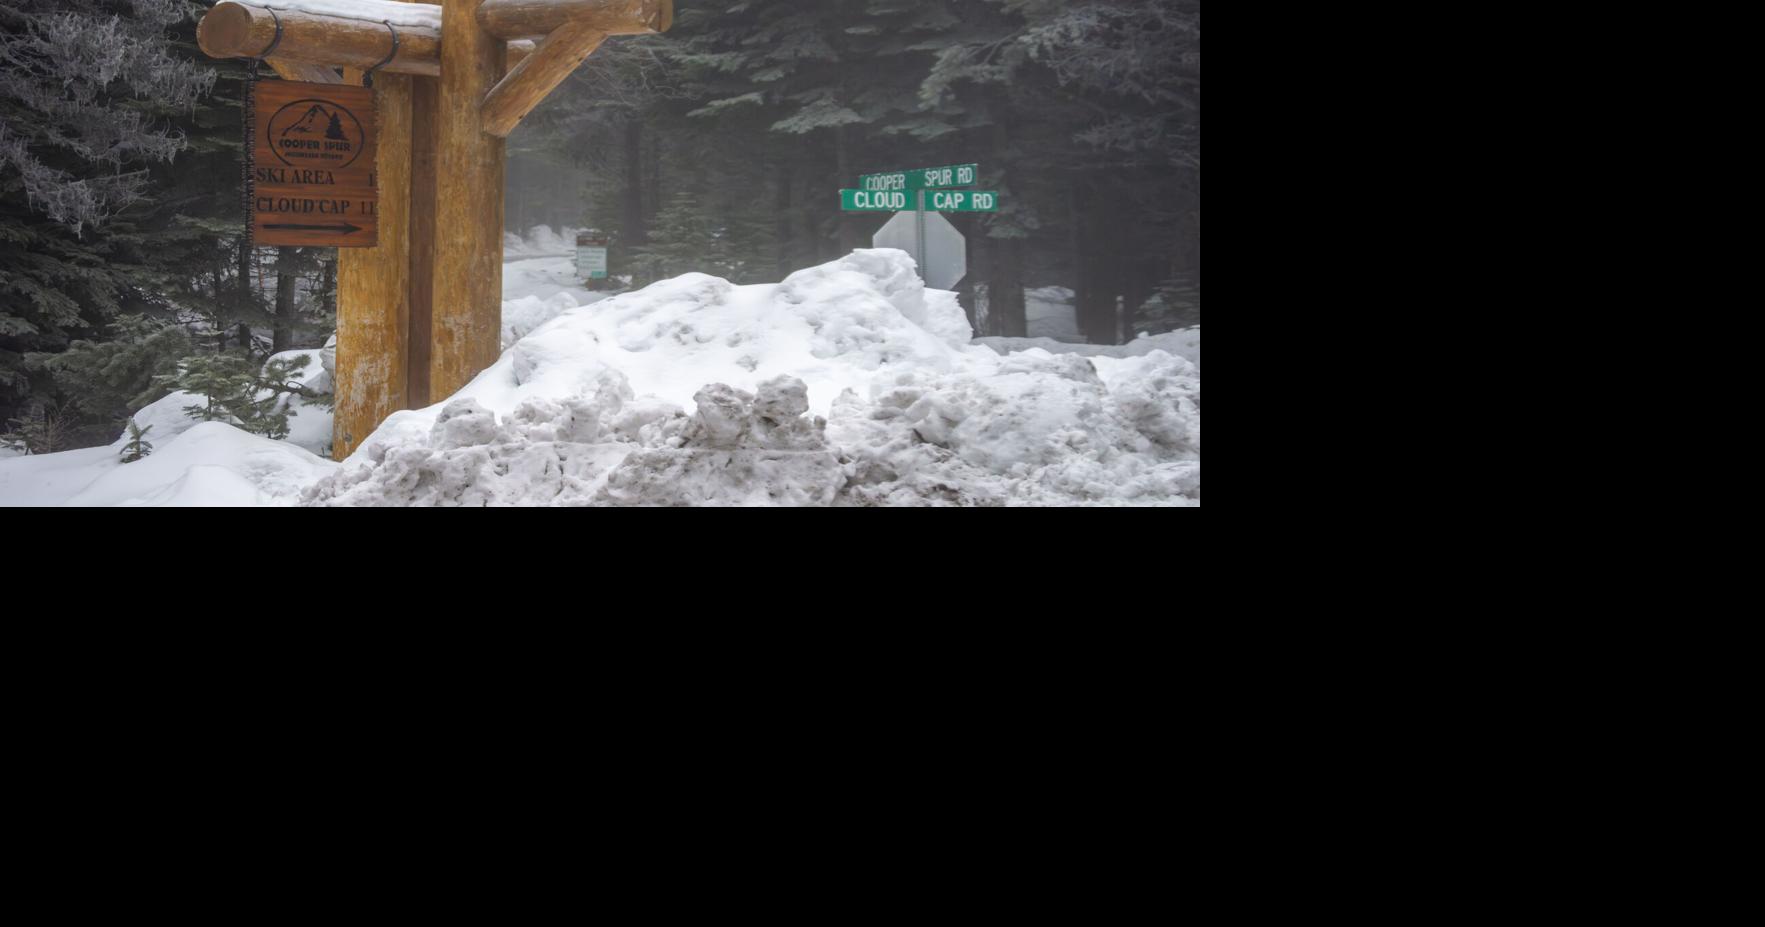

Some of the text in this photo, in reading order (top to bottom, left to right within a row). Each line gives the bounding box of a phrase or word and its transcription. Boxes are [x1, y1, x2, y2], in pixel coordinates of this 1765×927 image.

[279, 139, 352, 151] COOPER SPUR
[256, 168, 374, 187] SKI AREA 1
[866, 167, 973, 191] COOPER SPUR RD
[256, 197, 375, 215] CLOUD CAP 11
[854, 191, 993, 209] CLOUD CAP RD
